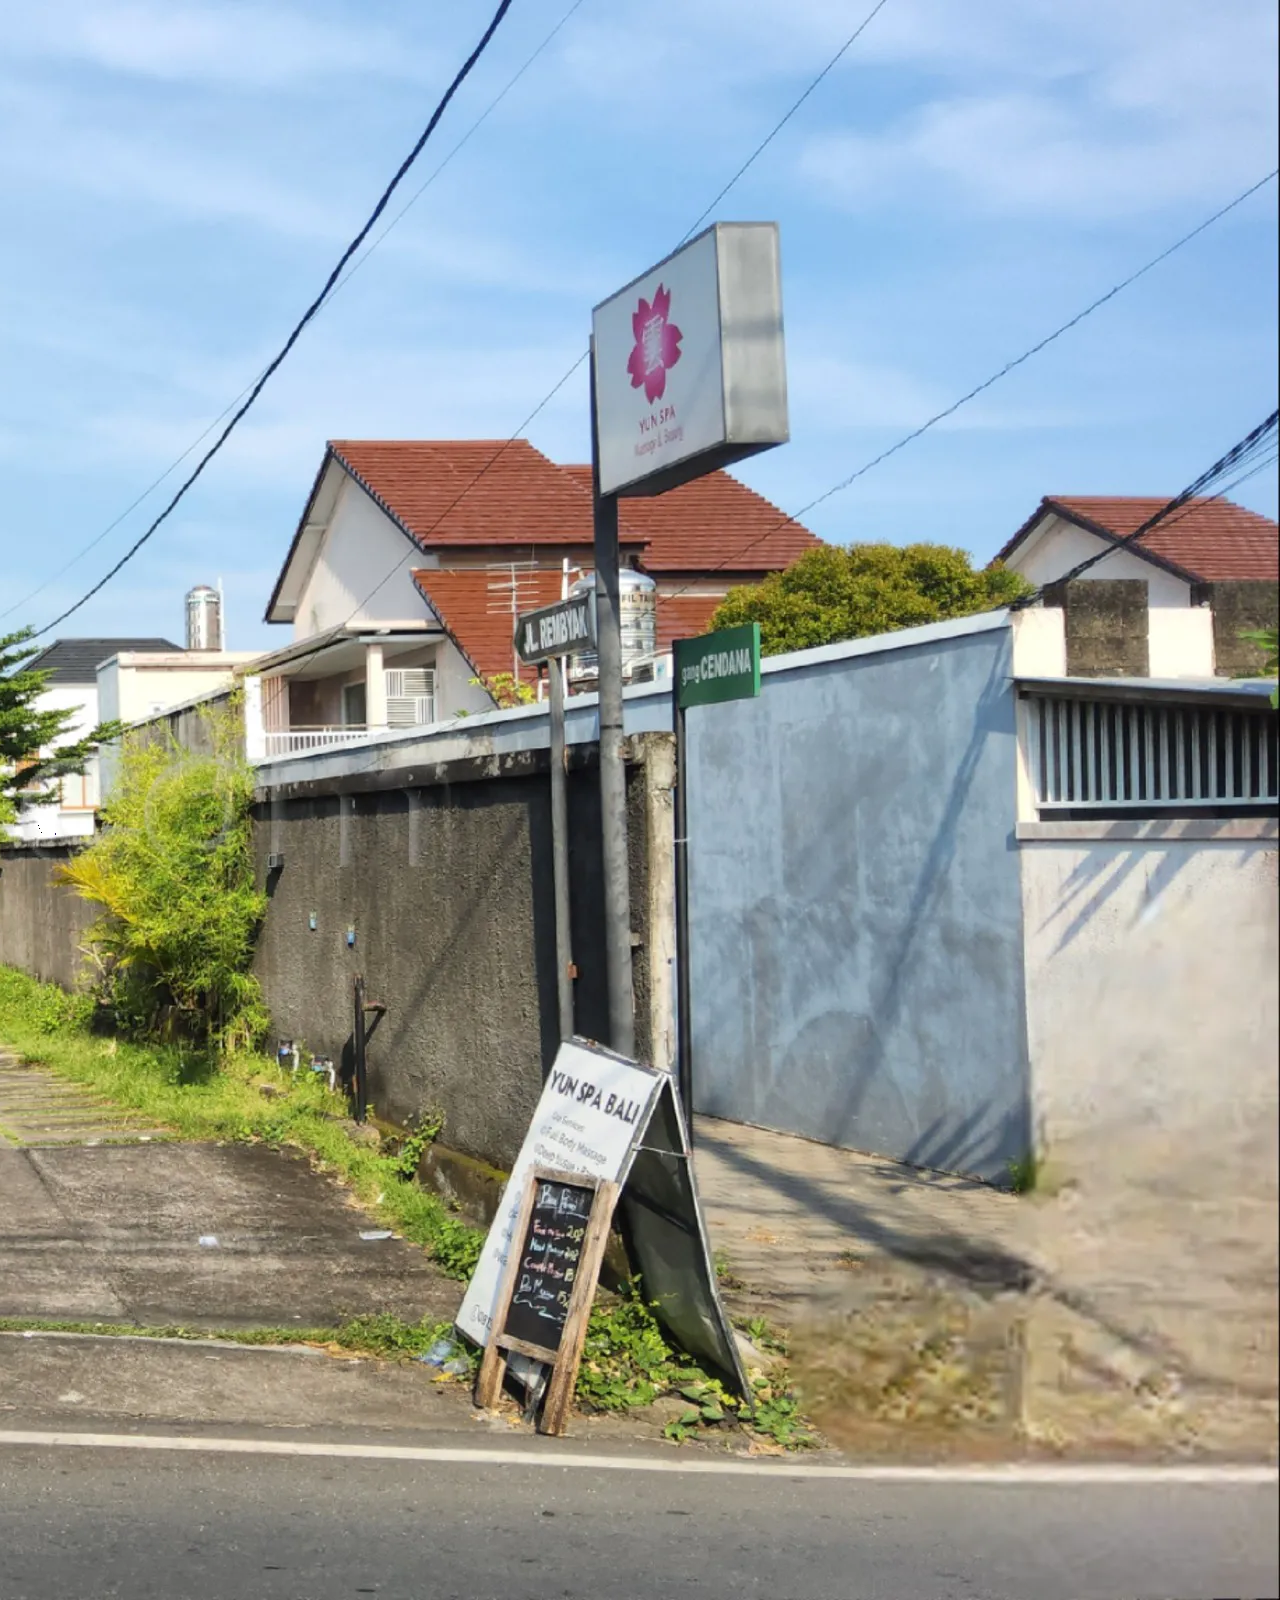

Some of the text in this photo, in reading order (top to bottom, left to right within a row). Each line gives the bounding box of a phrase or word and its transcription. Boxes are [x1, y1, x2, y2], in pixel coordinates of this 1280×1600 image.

[639, 404, 676, 435] YUN SPA
[700, 647, 752, 681] CENDANA
[550, 1070, 641, 1126] YUN SPA BALI
